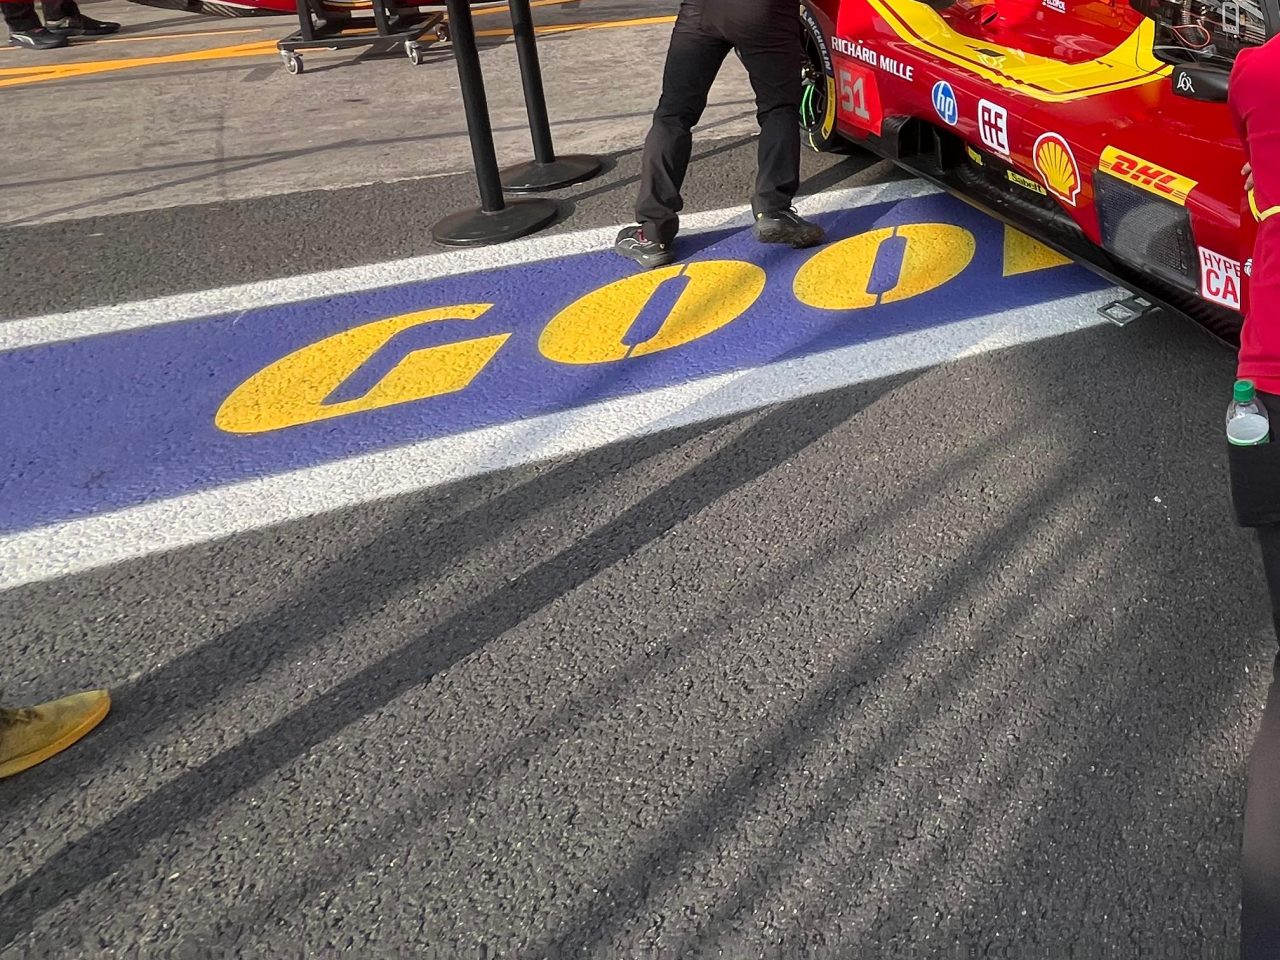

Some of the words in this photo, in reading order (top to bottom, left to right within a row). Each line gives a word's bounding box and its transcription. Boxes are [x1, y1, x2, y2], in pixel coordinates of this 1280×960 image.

[804, 14, 833, 72] MICHELIN
[831, 36, 878, 66] RICHARD
[879, 54, 914, 83] MILLE
[839, 68, 870, 121] 51
[936, 84, 954, 122] hp
[1012, 172, 1041, 193] Sabelt
[1110, 154, 1179, 195] DHL
[1203, 250, 1241, 278] HYPE
[1206, 268, 1239, 304] CA
